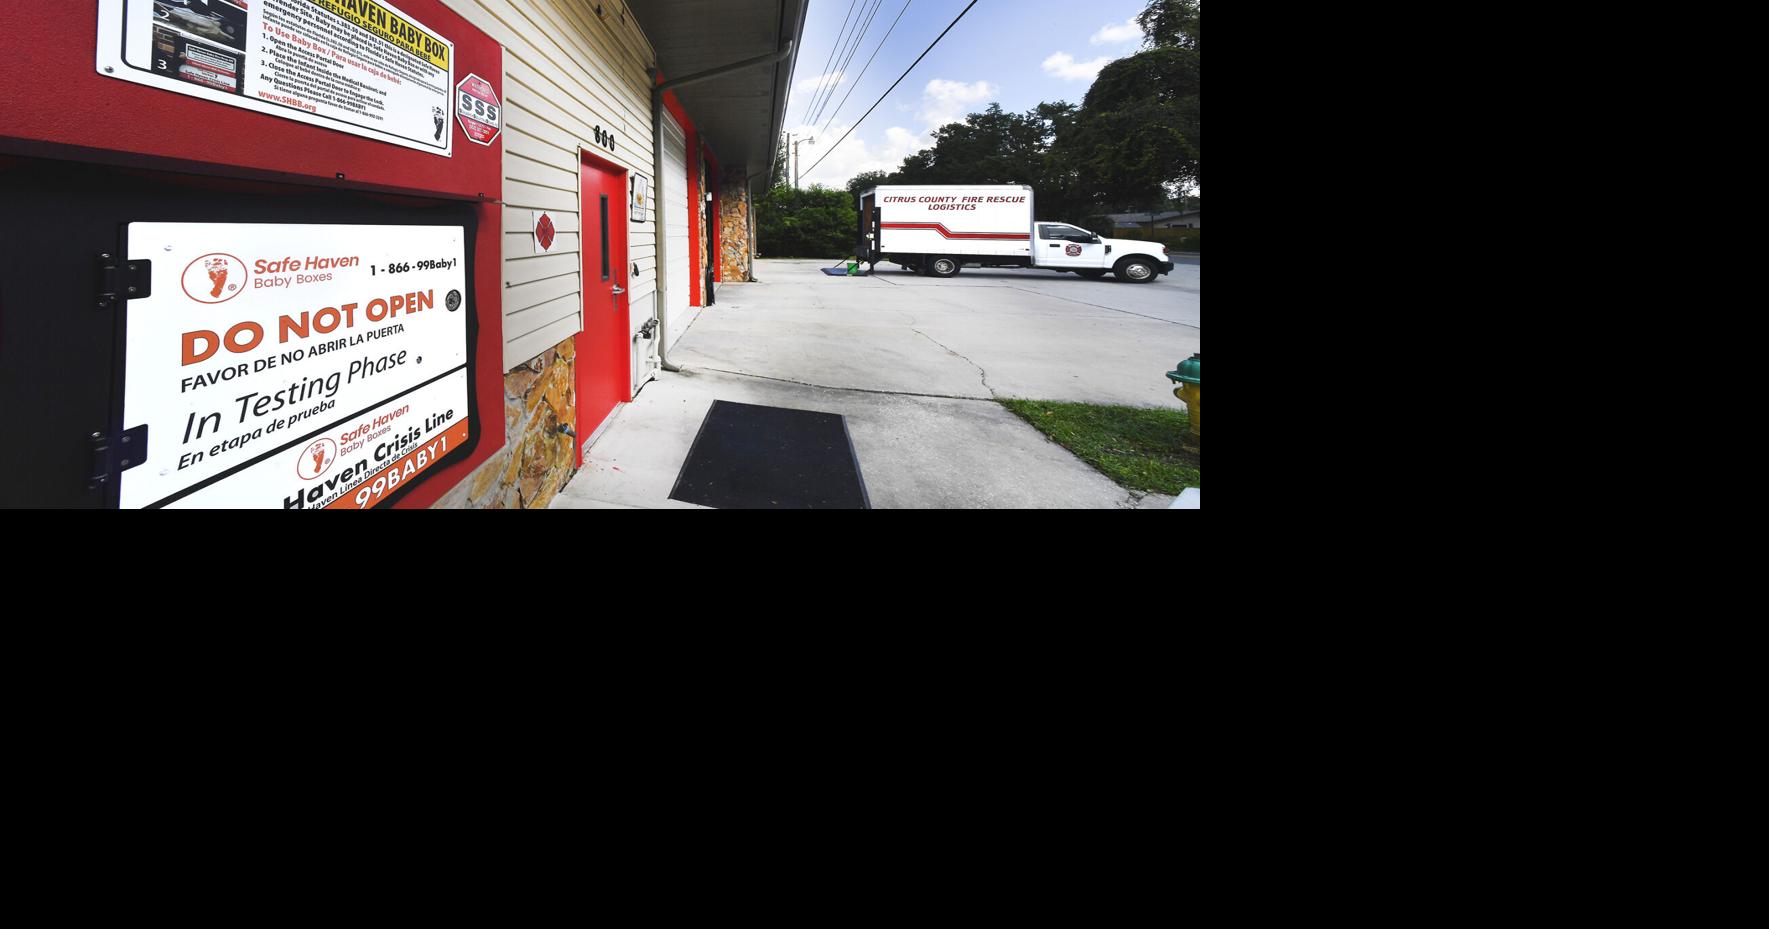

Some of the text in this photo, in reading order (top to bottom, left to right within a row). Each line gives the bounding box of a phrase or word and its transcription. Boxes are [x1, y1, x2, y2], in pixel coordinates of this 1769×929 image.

[160, 10, 170, 22] 2
[263, 0, 302, 22] emergency
[303, 18, 332, 36] personnel
[333, 33, 358, 48] according
[300, 8, 314, 20] Site.
[315, 15, 330, 28] Baby
[331, 24, 342, 34] may
[351, 34, 367, 45] placed
[311, 6, 335, 23] Statutes
[262, 22, 273, 32] To
[275, 27, 290, 39] Use
[291, 34, 311, 49] Baby
[312, 42, 326, 54] Box
[331, 50, 346, 62] Para
[347, 59, 361, 68] usar
[368, 67, 379, 76] caja
[269, 36, 286, 46] Open
[298, 47, 315, 58] Access
[316, 54, 332, 64] Portal
[332, 60, 344, 69] Door
[362, 20, 395, 42] SEGURO
[396, 39, 414, 53] PARA
[390, 16, 423, 47] BABY
[424, 36, 445, 62] BOX
[157, 59, 168, 70] 3
[268, 62, 284, 72] Close
[297, 72, 314, 82] Access
[315, 78, 331, 88] Portal
[332, 84, 343, 92] Door
[348, 90, 365, 100] Engage
[269, 48, 286, 60] Place
[298, 59, 316, 70] Infant
[316, 66, 332, 76] Inside
[342, 76, 359, 86] Medical
[258, 91, 316, 112] www.SHBB.org
[260, 73, 272, 83] Any
[274, 77, 303, 91] Questions
[304, 87, 321, 97] Please
[462, 94, 496, 120] SSS
[254, 256, 359, 274] Safe Haven
[254, 272, 332, 288] Baby Boxes
[182, 289, 434, 366] DO NOT OPEN
[181, 324, 404, 393] FAVOR DE NO ABRIR LA PUERTA
[182, 350, 407, 444] In Testing Phase
[177, 399, 336, 470] En etapa de prueba
[340, 404, 409, 446] Safe Haven
[340, 426, 392, 456] Baby Boxes
[284, 409, 454, 510] Haven Crisis Line
[356, 436, 446, 510] 99BABY1
[364, 460, 390, 479] Directa
[392, 452, 400, 462] de
[401, 442, 418, 456] Crisis
